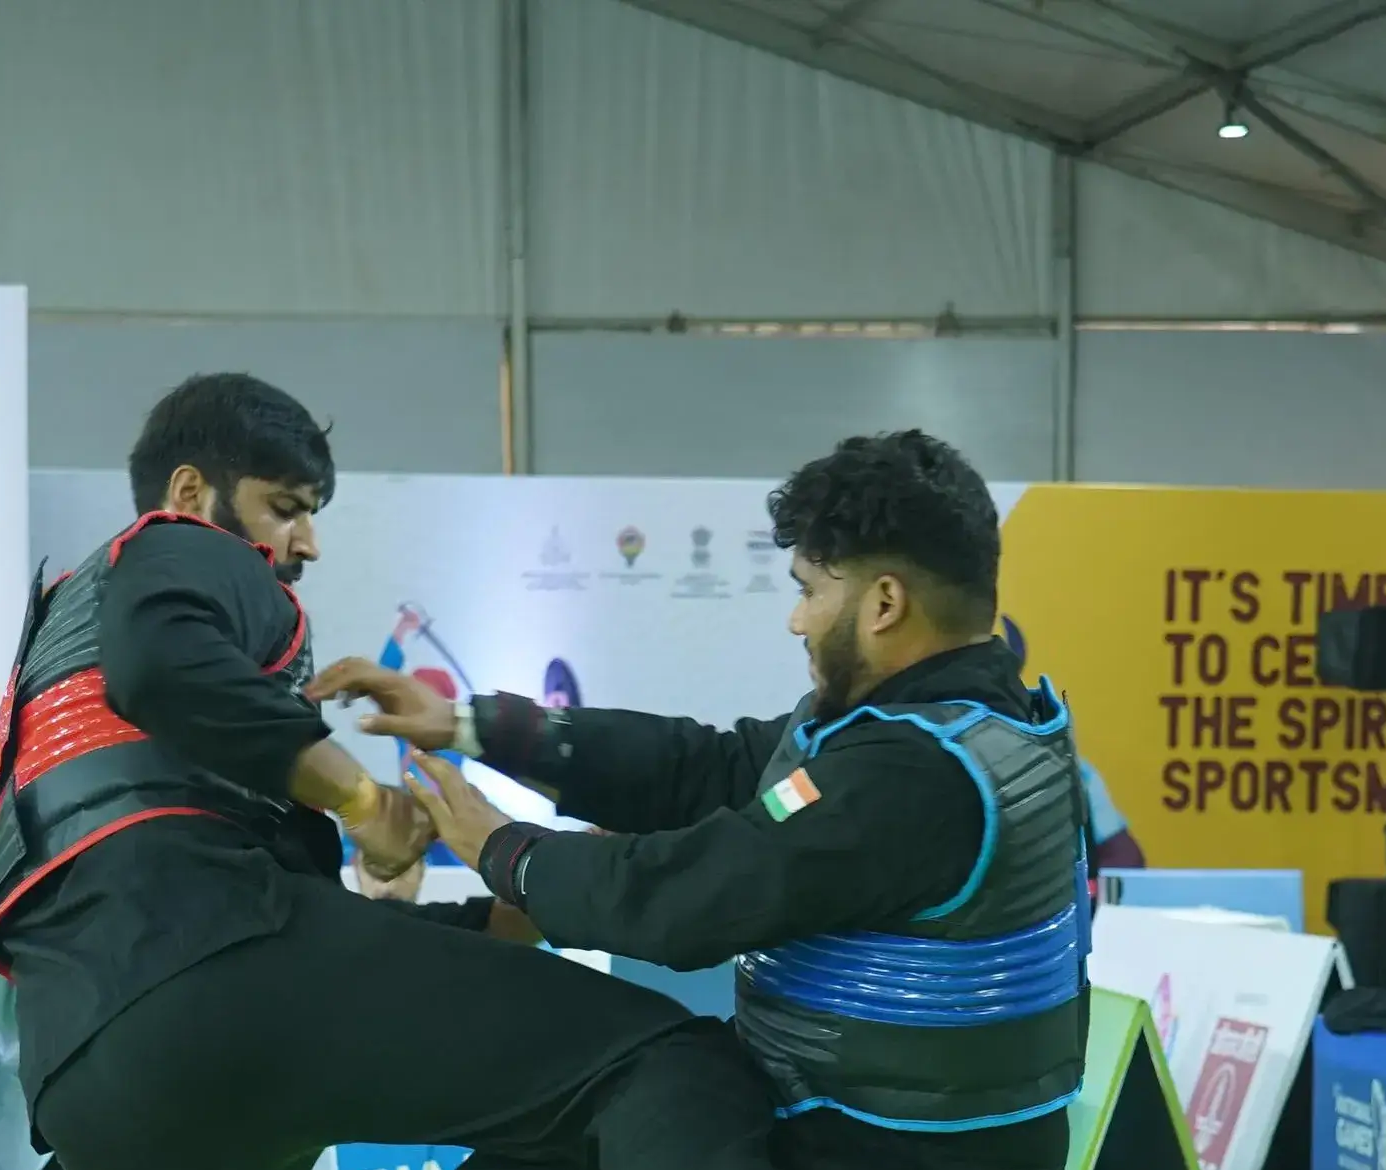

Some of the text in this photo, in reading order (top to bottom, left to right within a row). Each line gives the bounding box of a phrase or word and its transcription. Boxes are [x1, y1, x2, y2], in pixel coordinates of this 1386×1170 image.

[1165, 569, 1260, 624] IT'S
[1164, 633, 1228, 687] TO
[1159, 696, 1257, 750] THE
